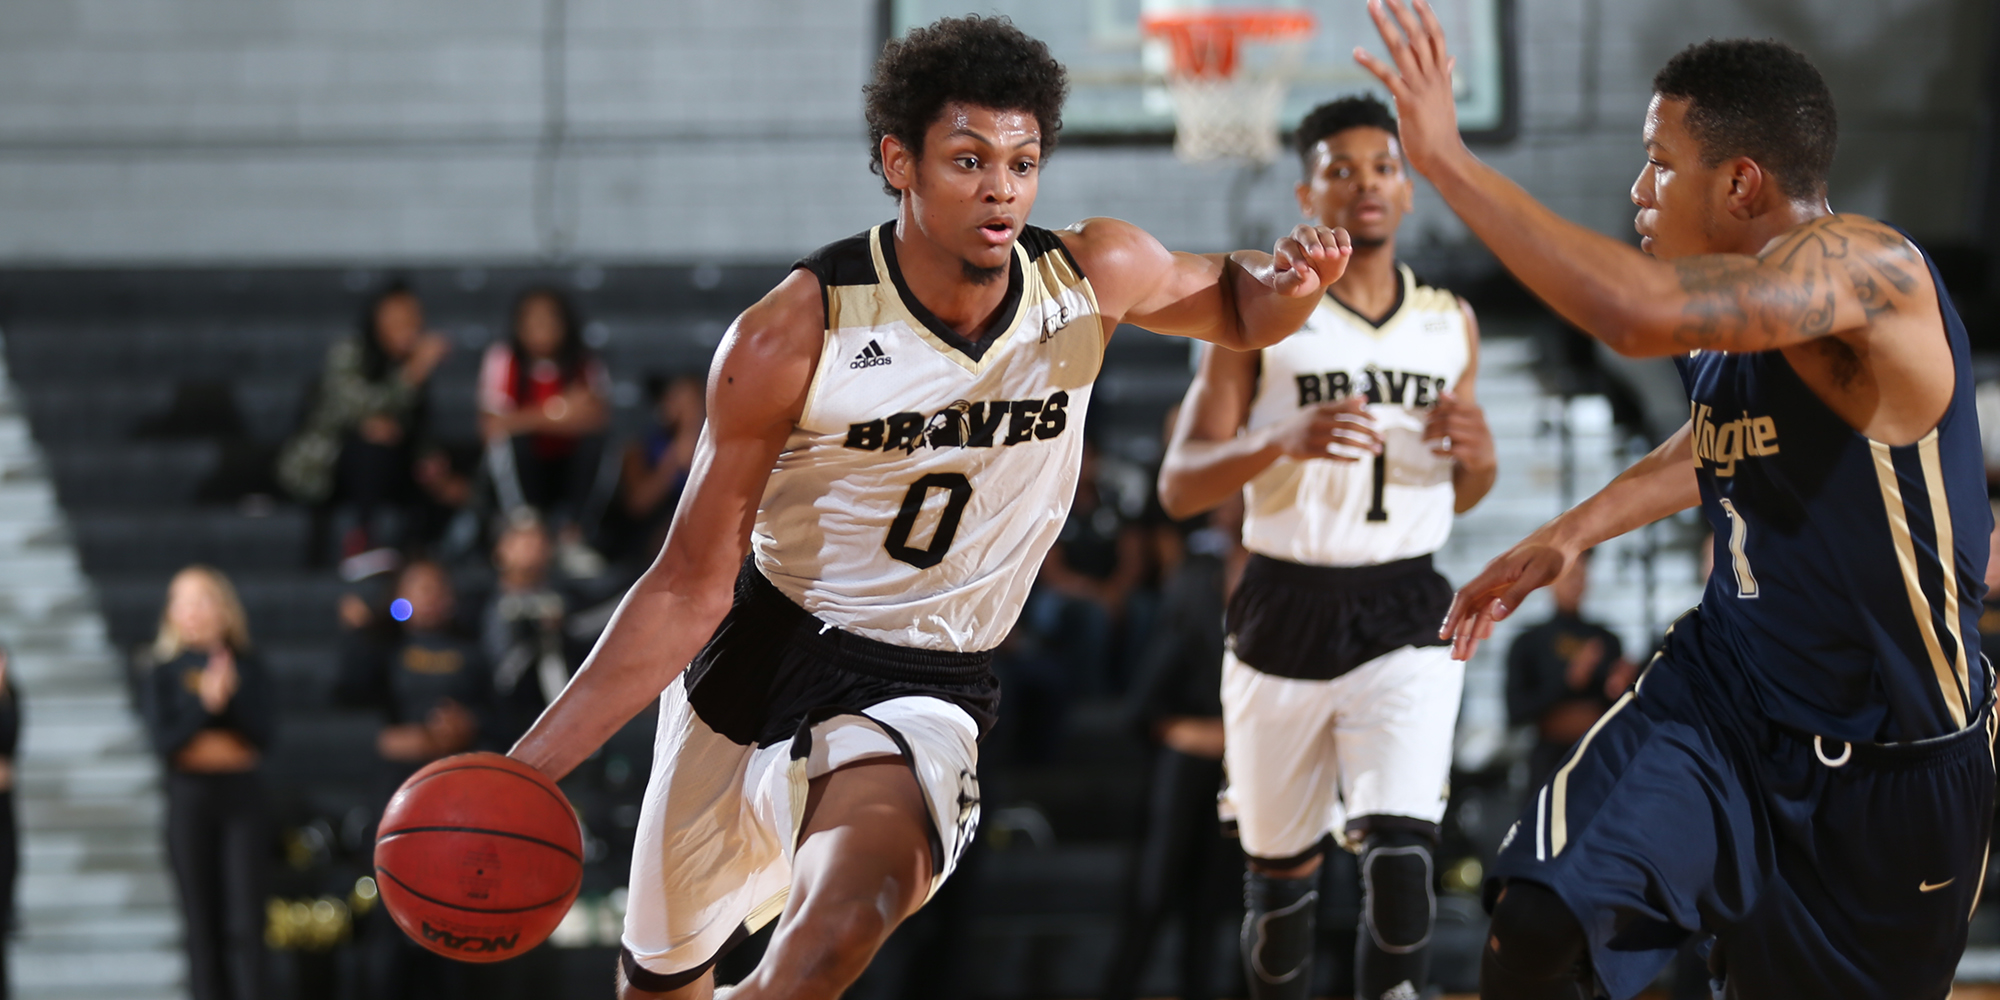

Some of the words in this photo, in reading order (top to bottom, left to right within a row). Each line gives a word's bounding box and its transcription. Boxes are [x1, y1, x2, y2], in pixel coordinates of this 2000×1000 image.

[850, 356, 892, 369] adidas
[844, 390, 1068, 456] BRAVES
[1366, 438, 1388, 522] 1
[884, 472, 973, 570] 0
[1719, 497, 1759, 599] 1
[421, 921, 520, 953] NCAA
